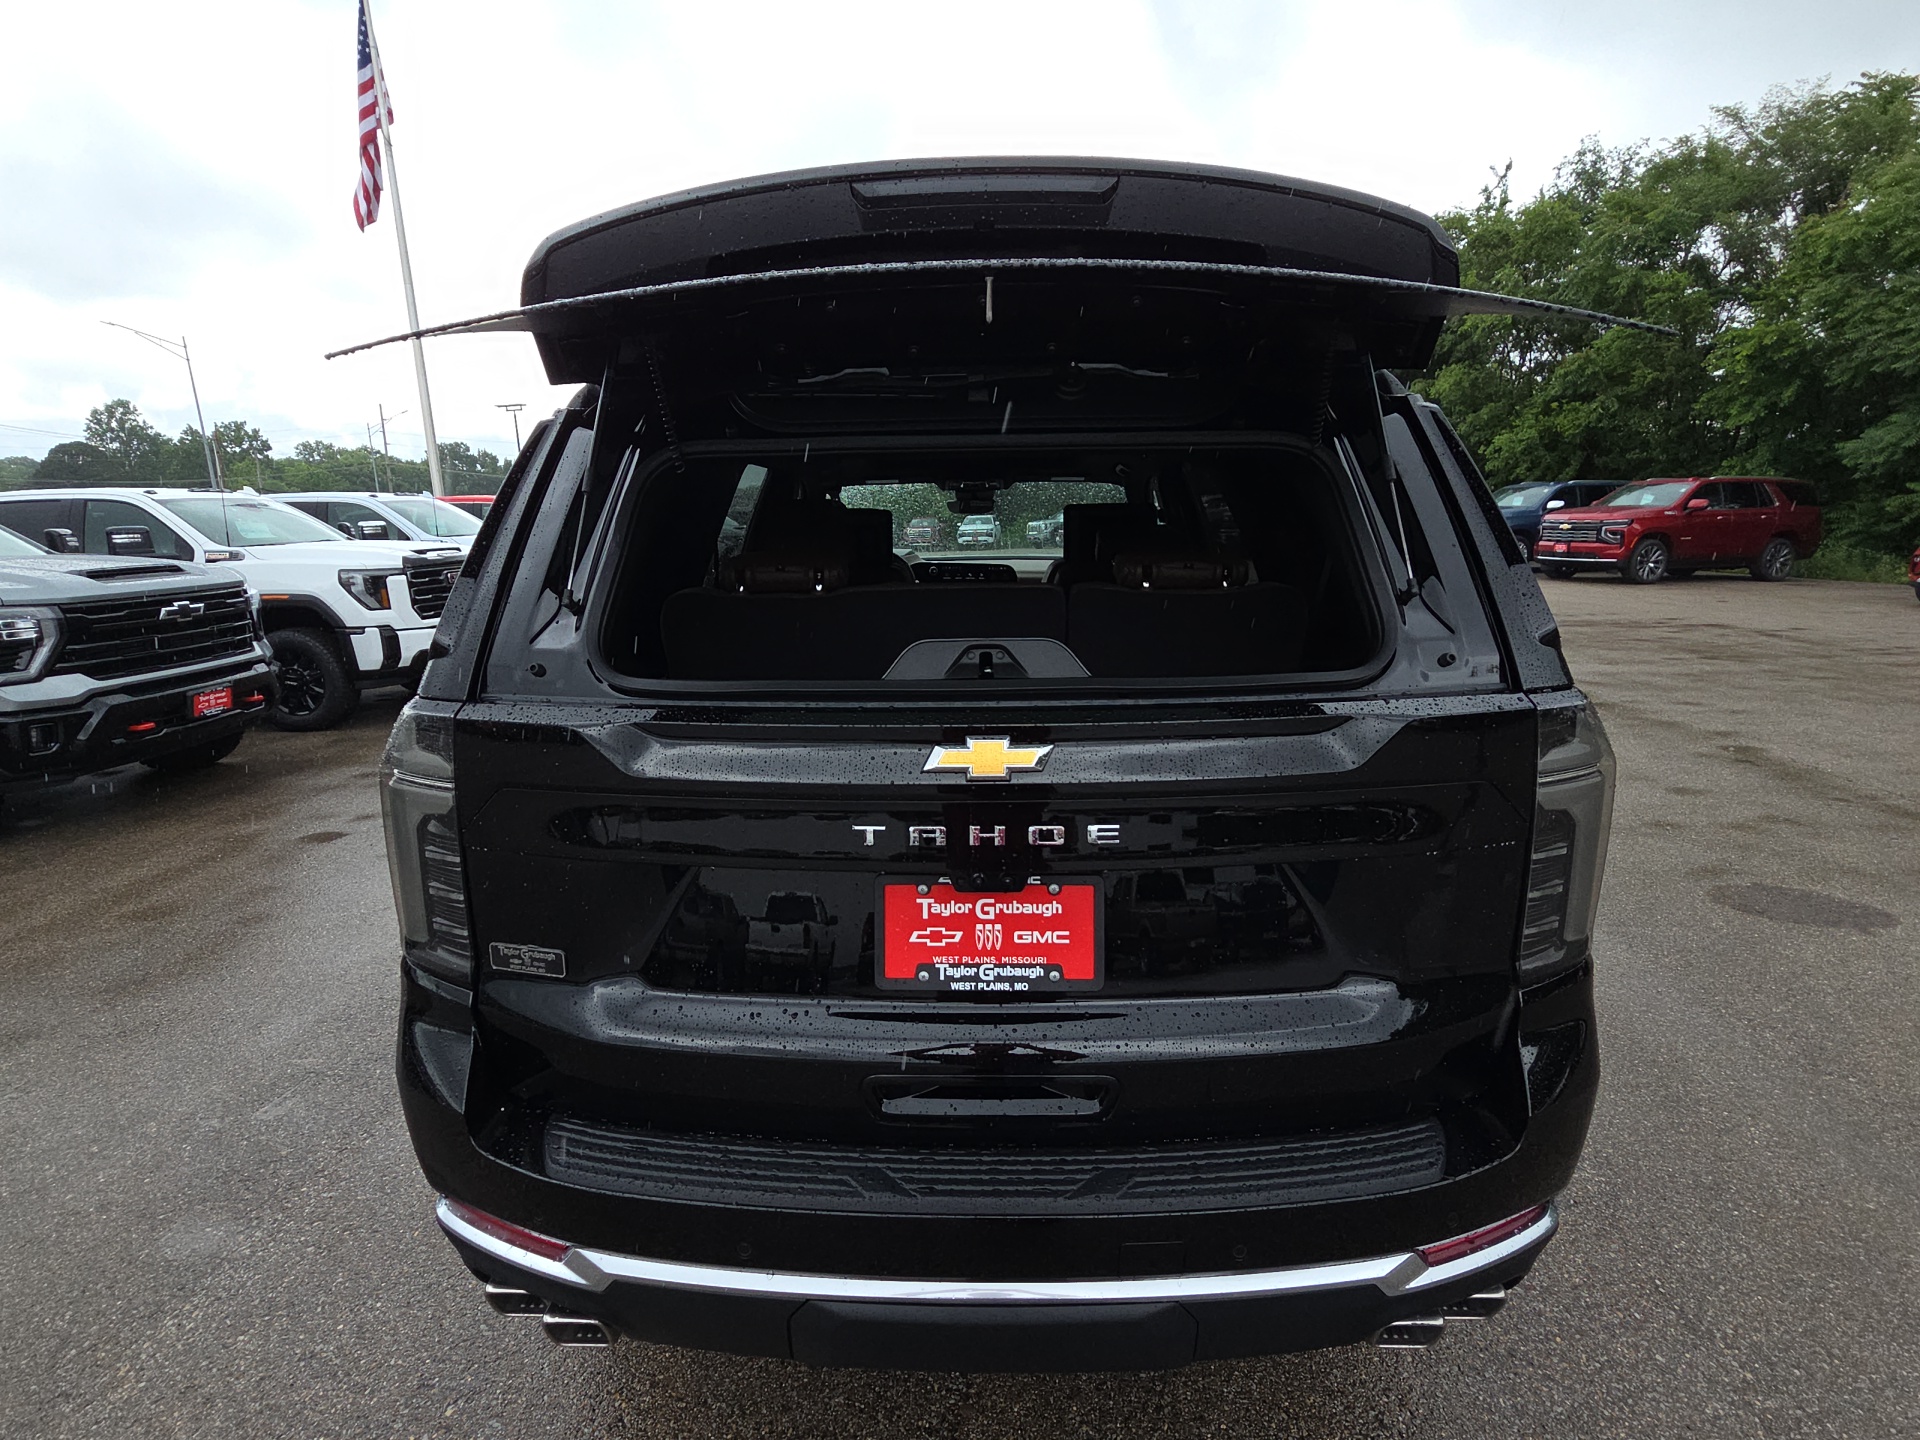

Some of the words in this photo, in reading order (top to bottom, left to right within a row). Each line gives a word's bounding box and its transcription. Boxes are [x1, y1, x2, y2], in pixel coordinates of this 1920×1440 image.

[852, 825, 1120, 846] TAHOE
[916, 898, 973, 920] Taylor
[975, 898, 1063, 920] Grubaugh
[1013, 930, 1070, 944] GMC
[932, 956, 960, 964] WEST
[1001, 956, 1047, 965] MISSOURI
[935, 963, 977, 980] Taylor
[979, 963, 1044, 980] Grubaugh
[950, 982, 976, 991] WEST
[978, 982, 1012, 992] PLAINS,
[1014, 982, 1029, 991] MO
